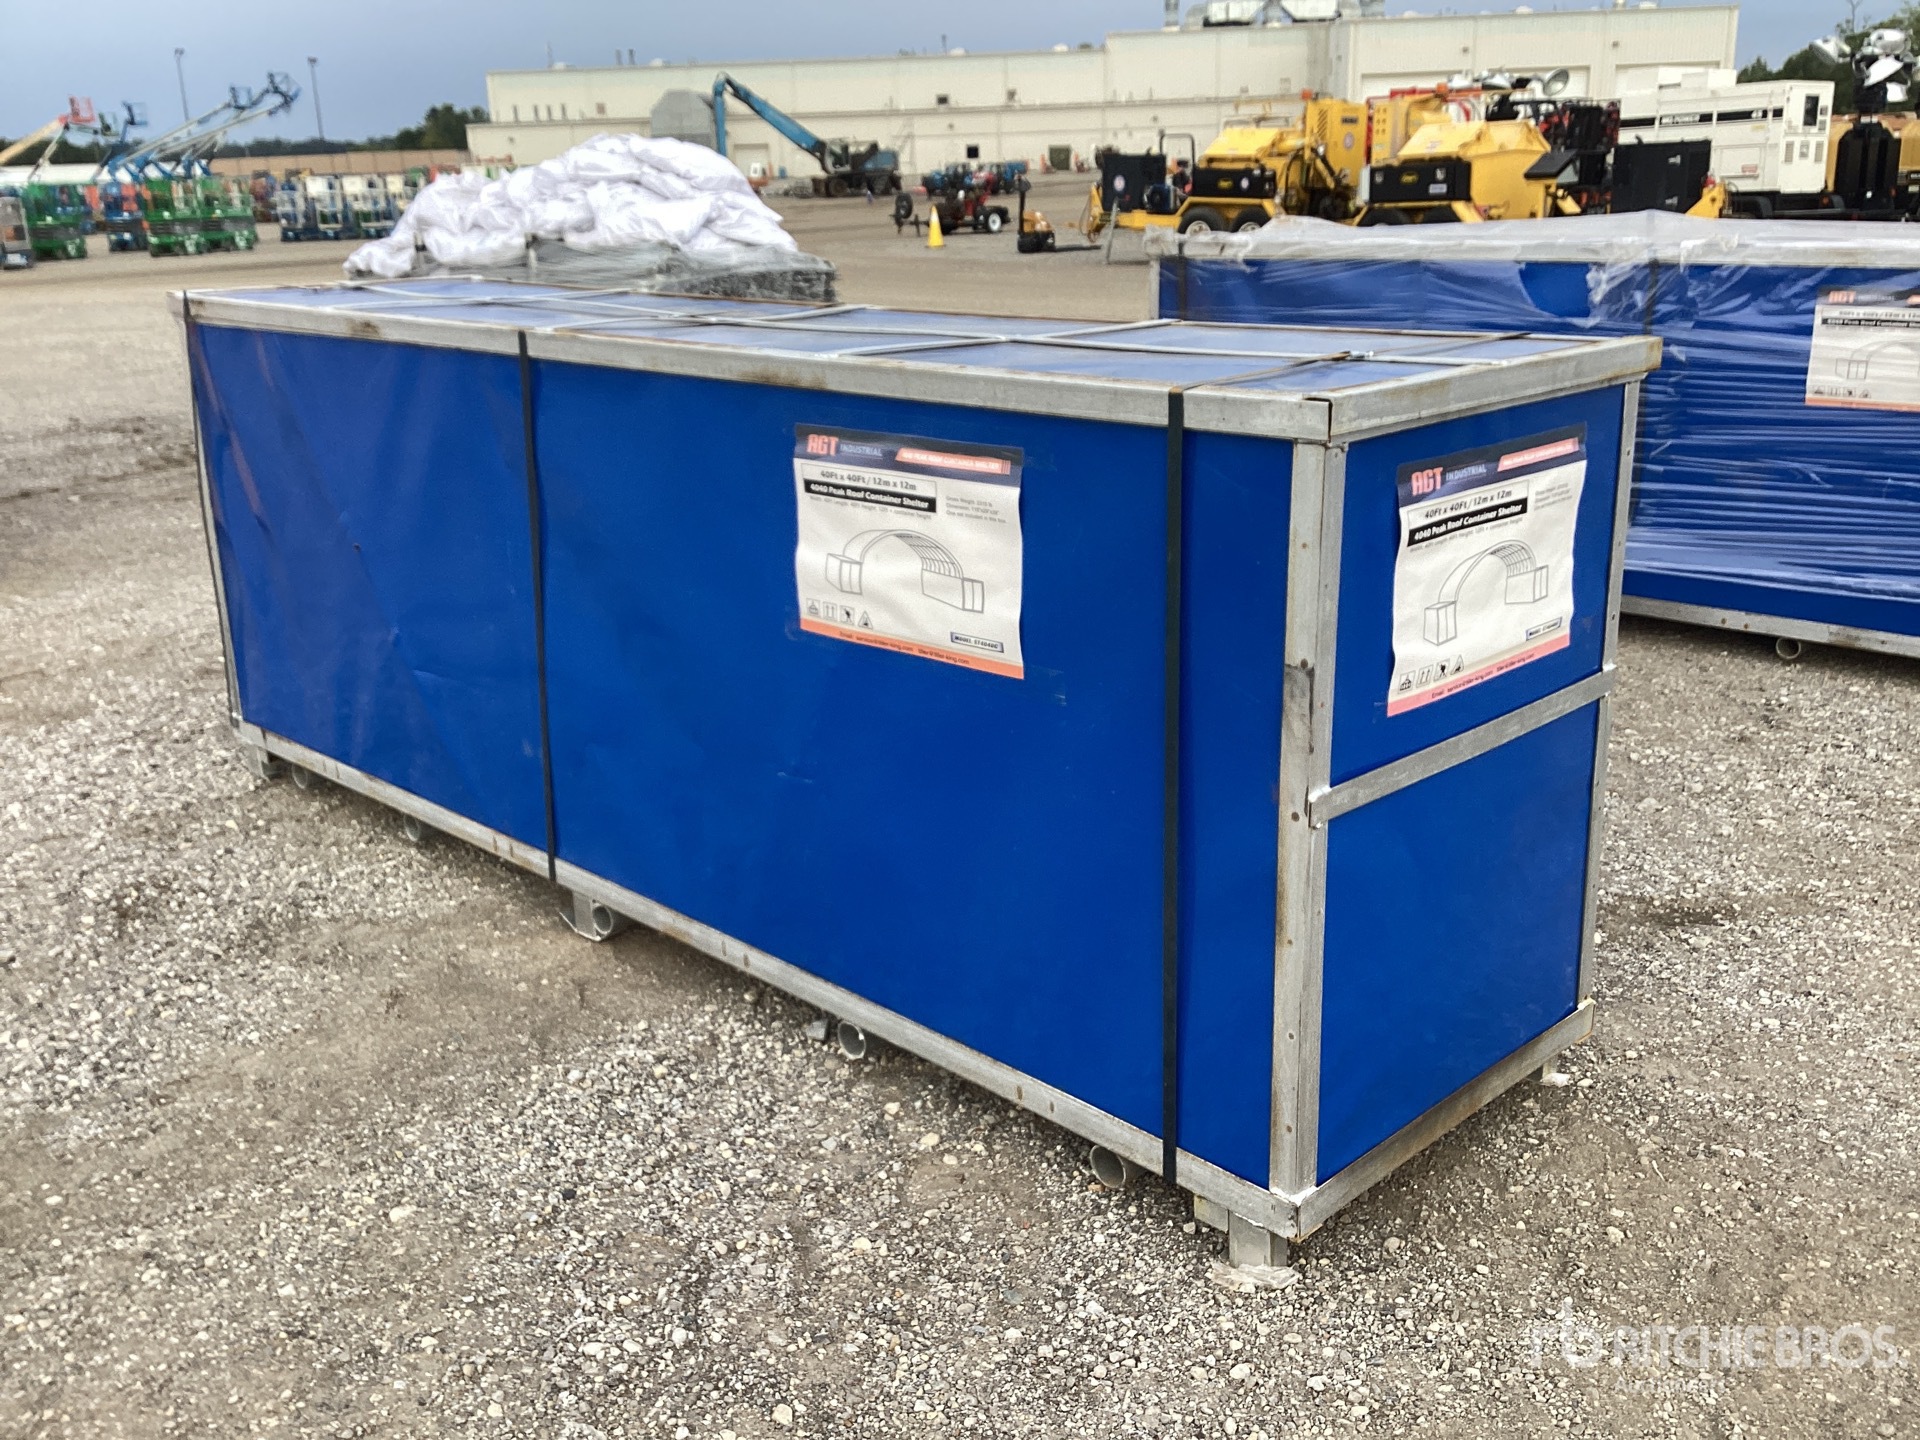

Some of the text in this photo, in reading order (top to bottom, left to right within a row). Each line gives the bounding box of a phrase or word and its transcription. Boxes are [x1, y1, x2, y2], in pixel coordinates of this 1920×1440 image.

[806, 433, 882, 457] AGT INDUSTRIAL
[820, 470, 838, 480] 40Ft
[847, 473, 866, 484] 40Ft
[872, 476, 891, 487] 12m
[900, 480, 917, 490] 12m
[1411, 463, 1487, 496] AGT INDUSTRIAL
[810, 483, 929, 509] 4040 Peak Roof Container Shelter
[1425, 507, 1442, 519] 40Ft
[1449, 501, 1467, 513] 40Ft
[1473, 495, 1488, 507] 12m
[1496, 489, 1512, 500] 12m
[1414, 528, 1431, 541] 4040
[1432, 523, 1447, 536] Peak
[1447, 517, 1463, 530] Roof
[1463, 509, 1498, 525] Container
[1498, 503, 1523, 517] Shelter
